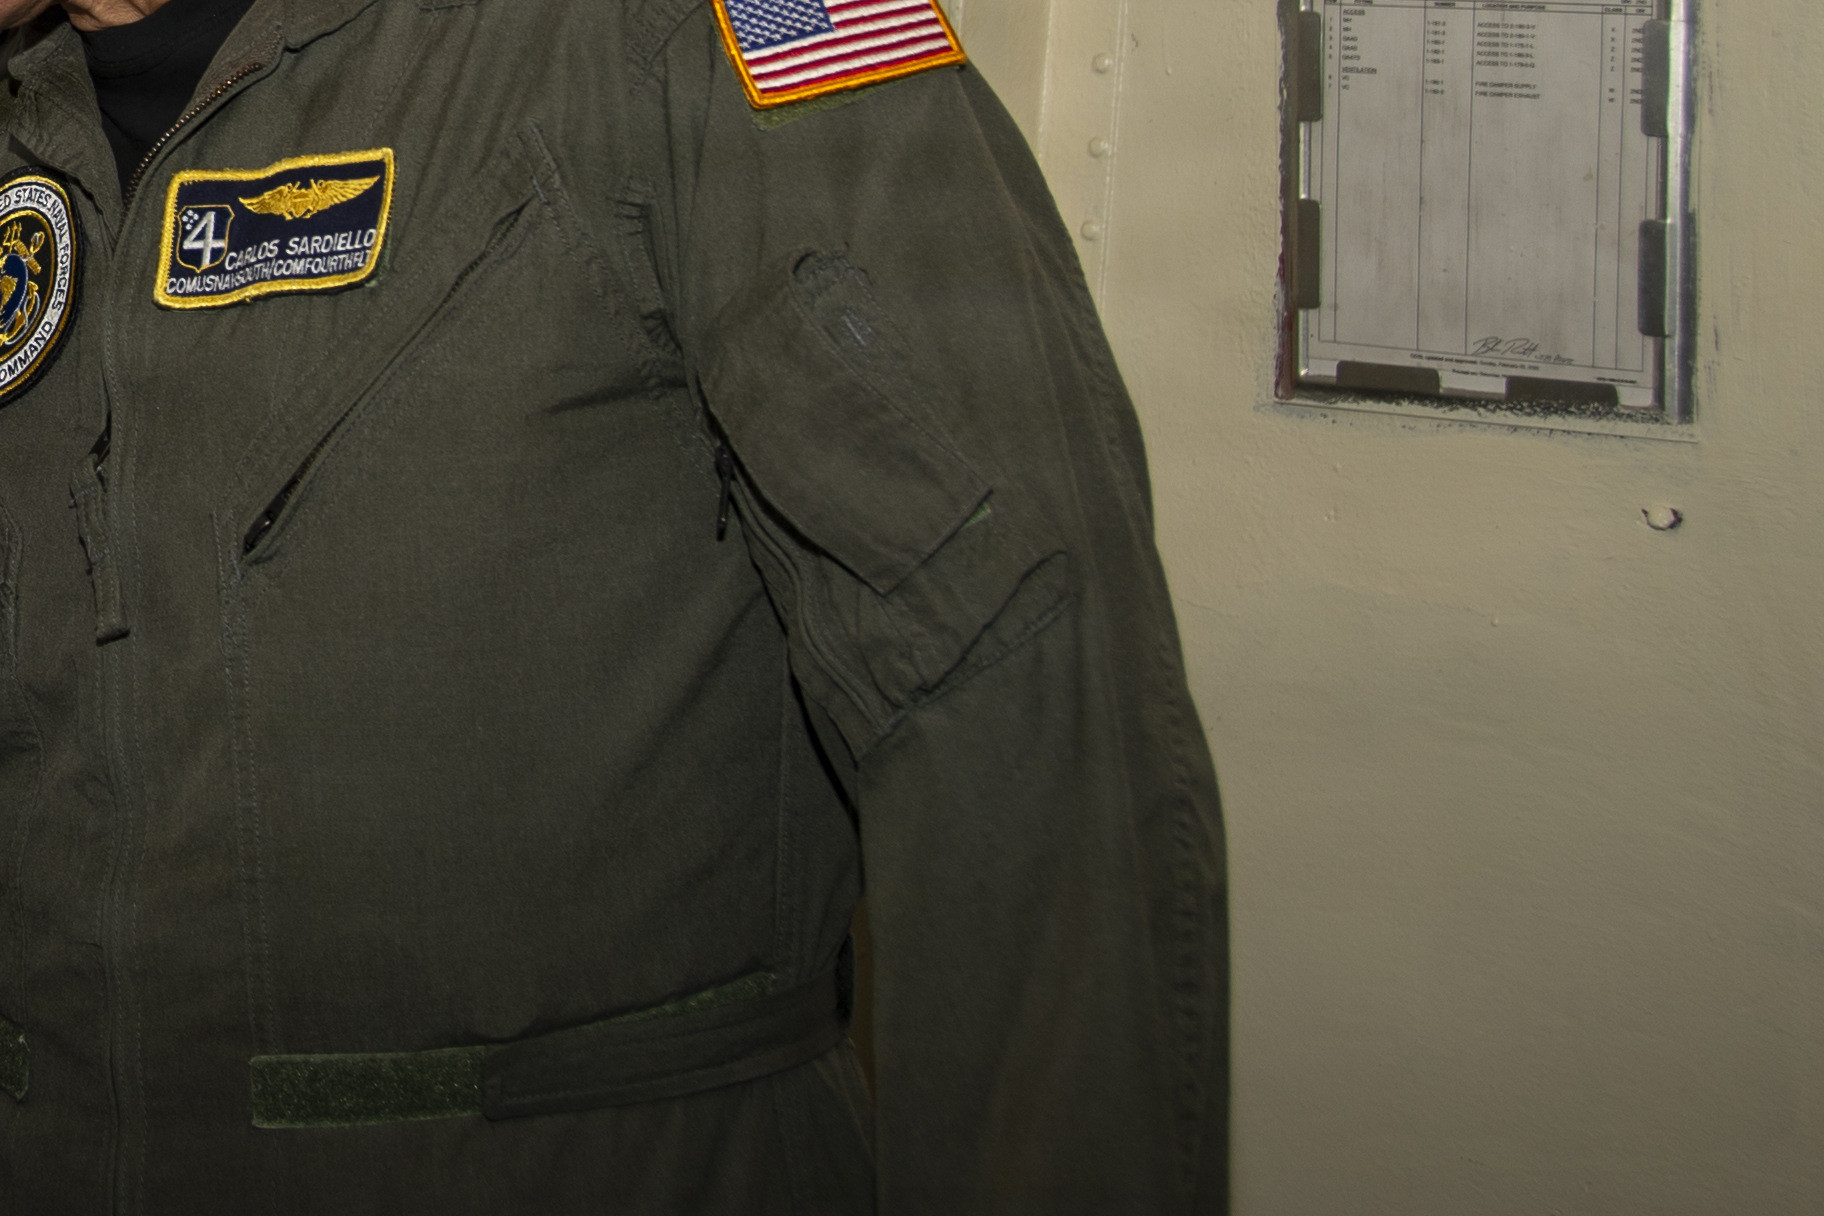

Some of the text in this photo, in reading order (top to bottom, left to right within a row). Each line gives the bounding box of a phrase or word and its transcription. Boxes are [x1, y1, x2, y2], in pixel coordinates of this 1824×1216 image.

[13, 188, 51, 209] STATES
[47, 200, 65, 244] NAVAL
[182, 211, 225, 265] 4
[224, 228, 377, 270] CARLOS SARDIELLO
[52, 243, 71, 311] FORCES
